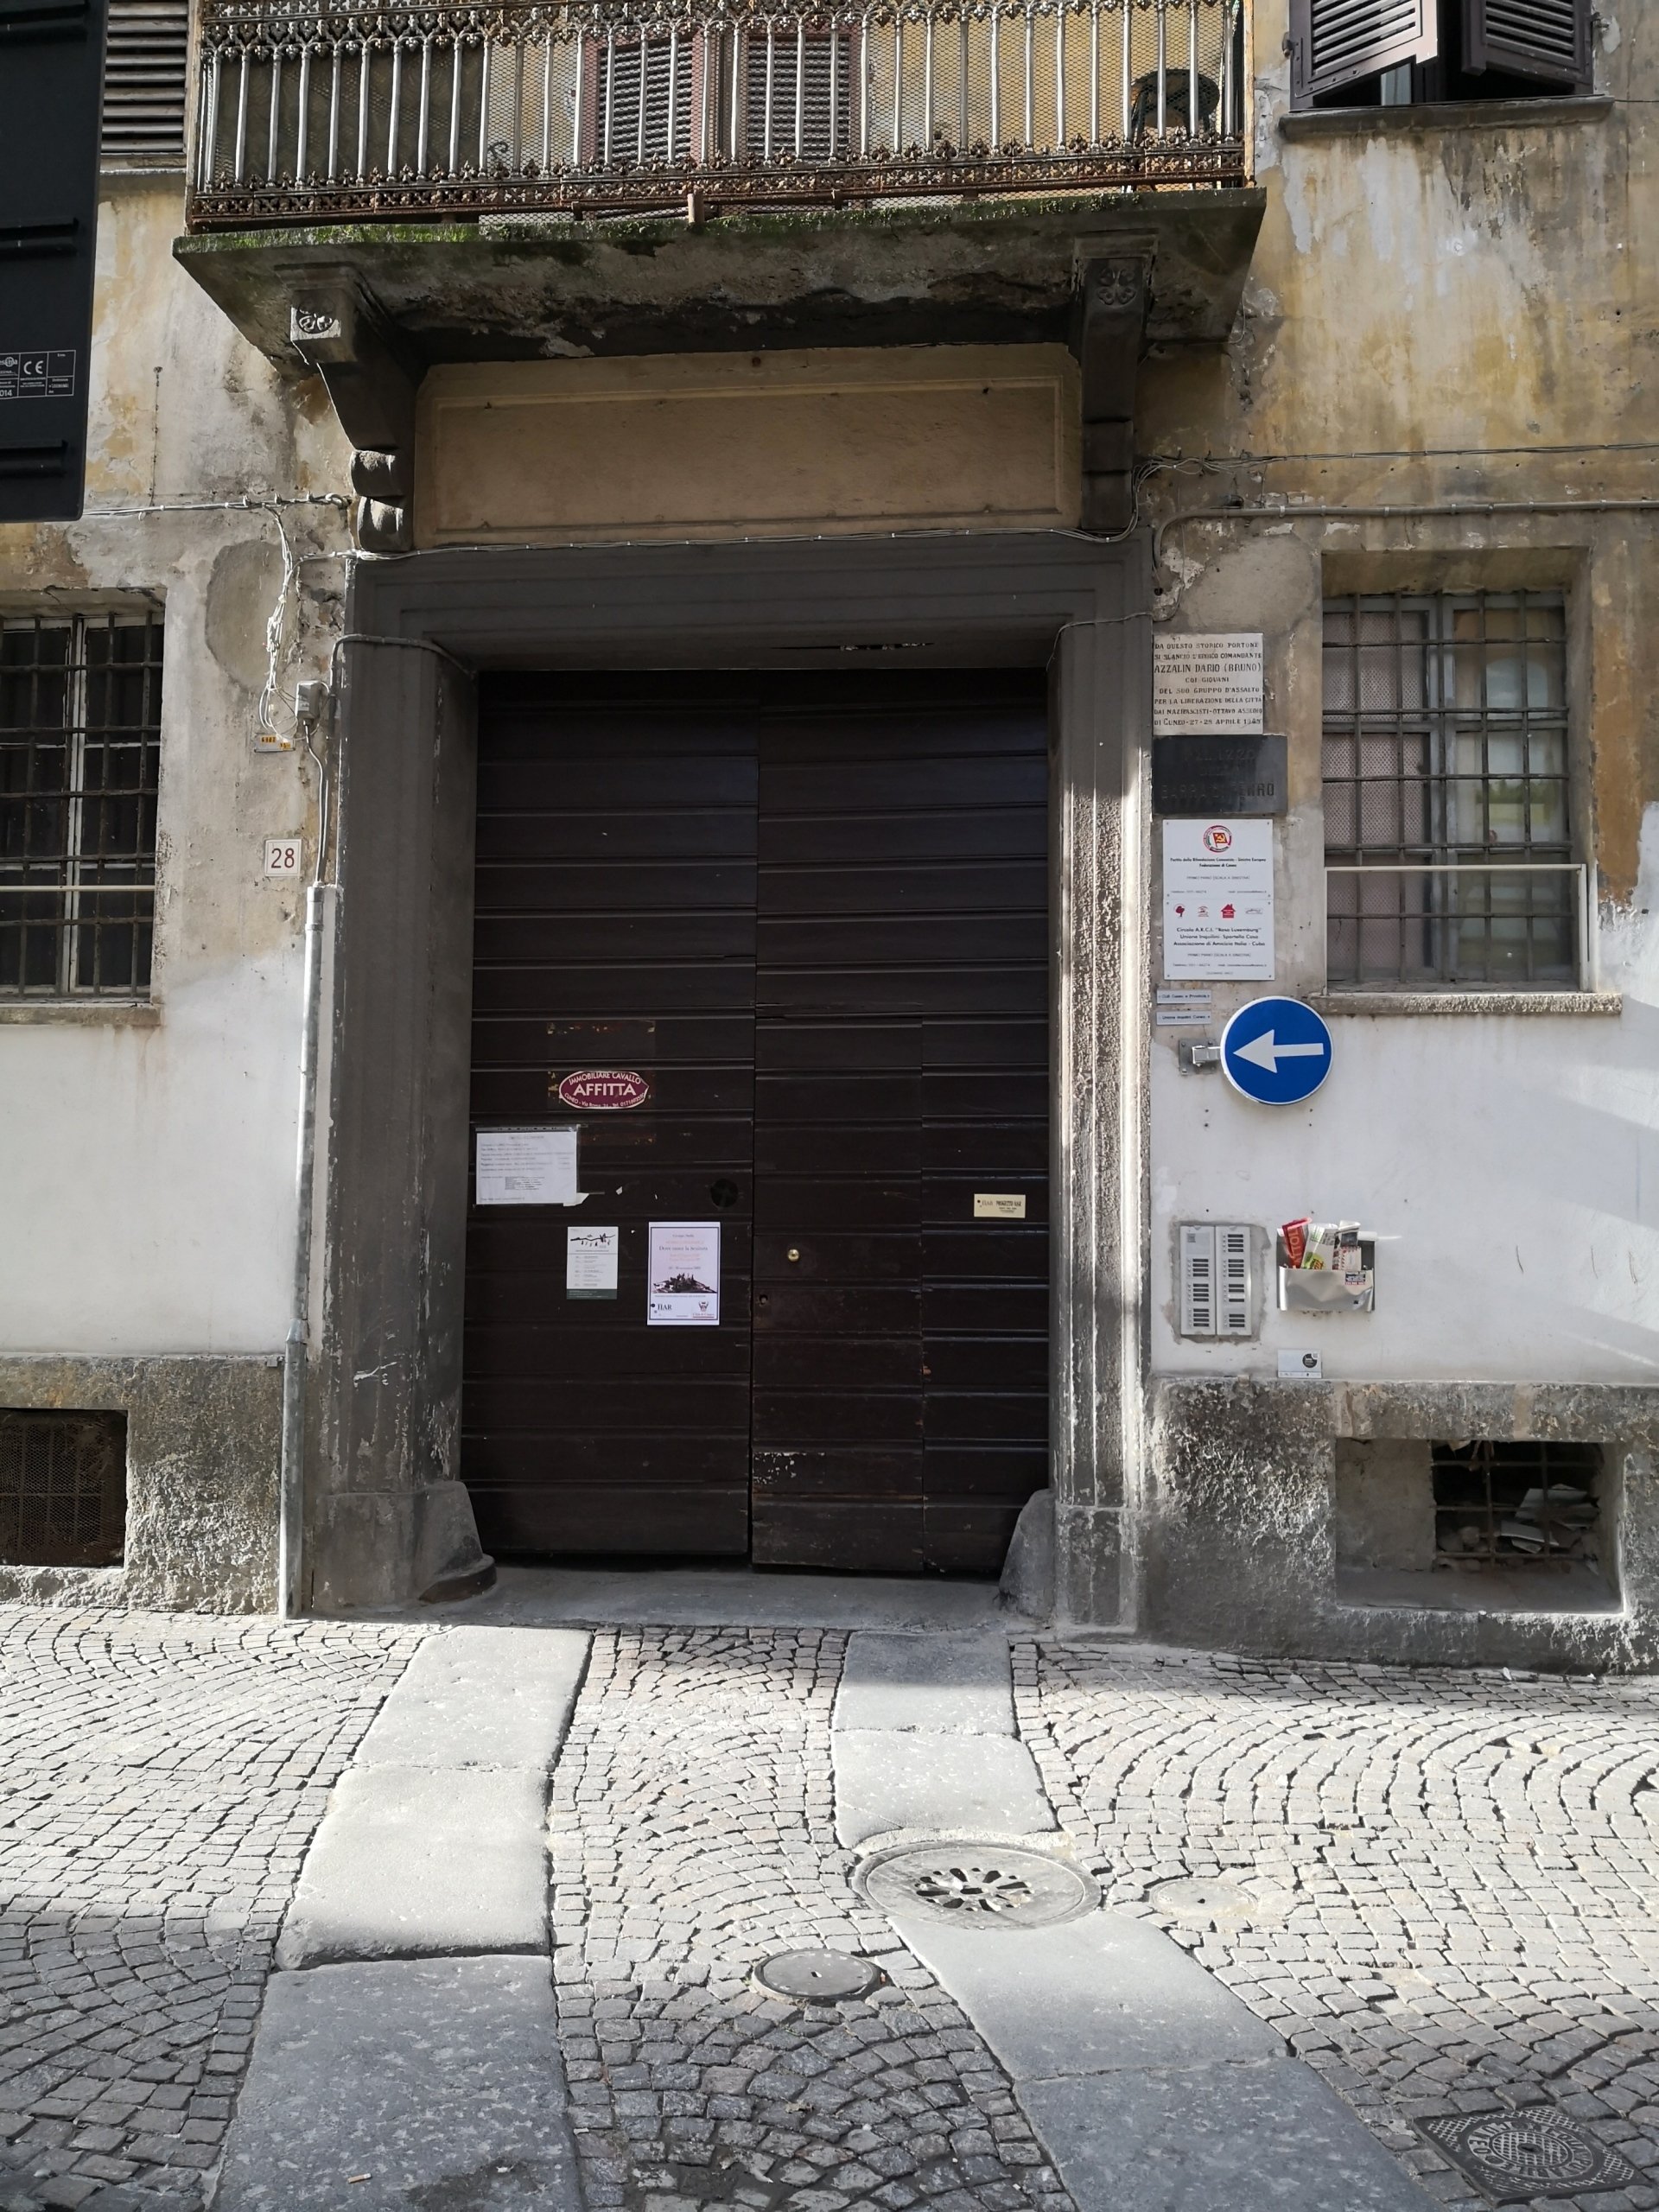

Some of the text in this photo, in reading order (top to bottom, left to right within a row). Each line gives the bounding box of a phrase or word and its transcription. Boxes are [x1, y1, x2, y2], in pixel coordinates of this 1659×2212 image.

[1154, 663, 1261, 673] AZZALIN DARIO (BRUNO)
[270, 848, 295, 868] 28
[569, 1071, 641, 1086] IMMOBILIARE CAVALLO
[573, 1083, 636, 1096] AFFITTA
[564, 1093, 578, 1104] CUNEO
